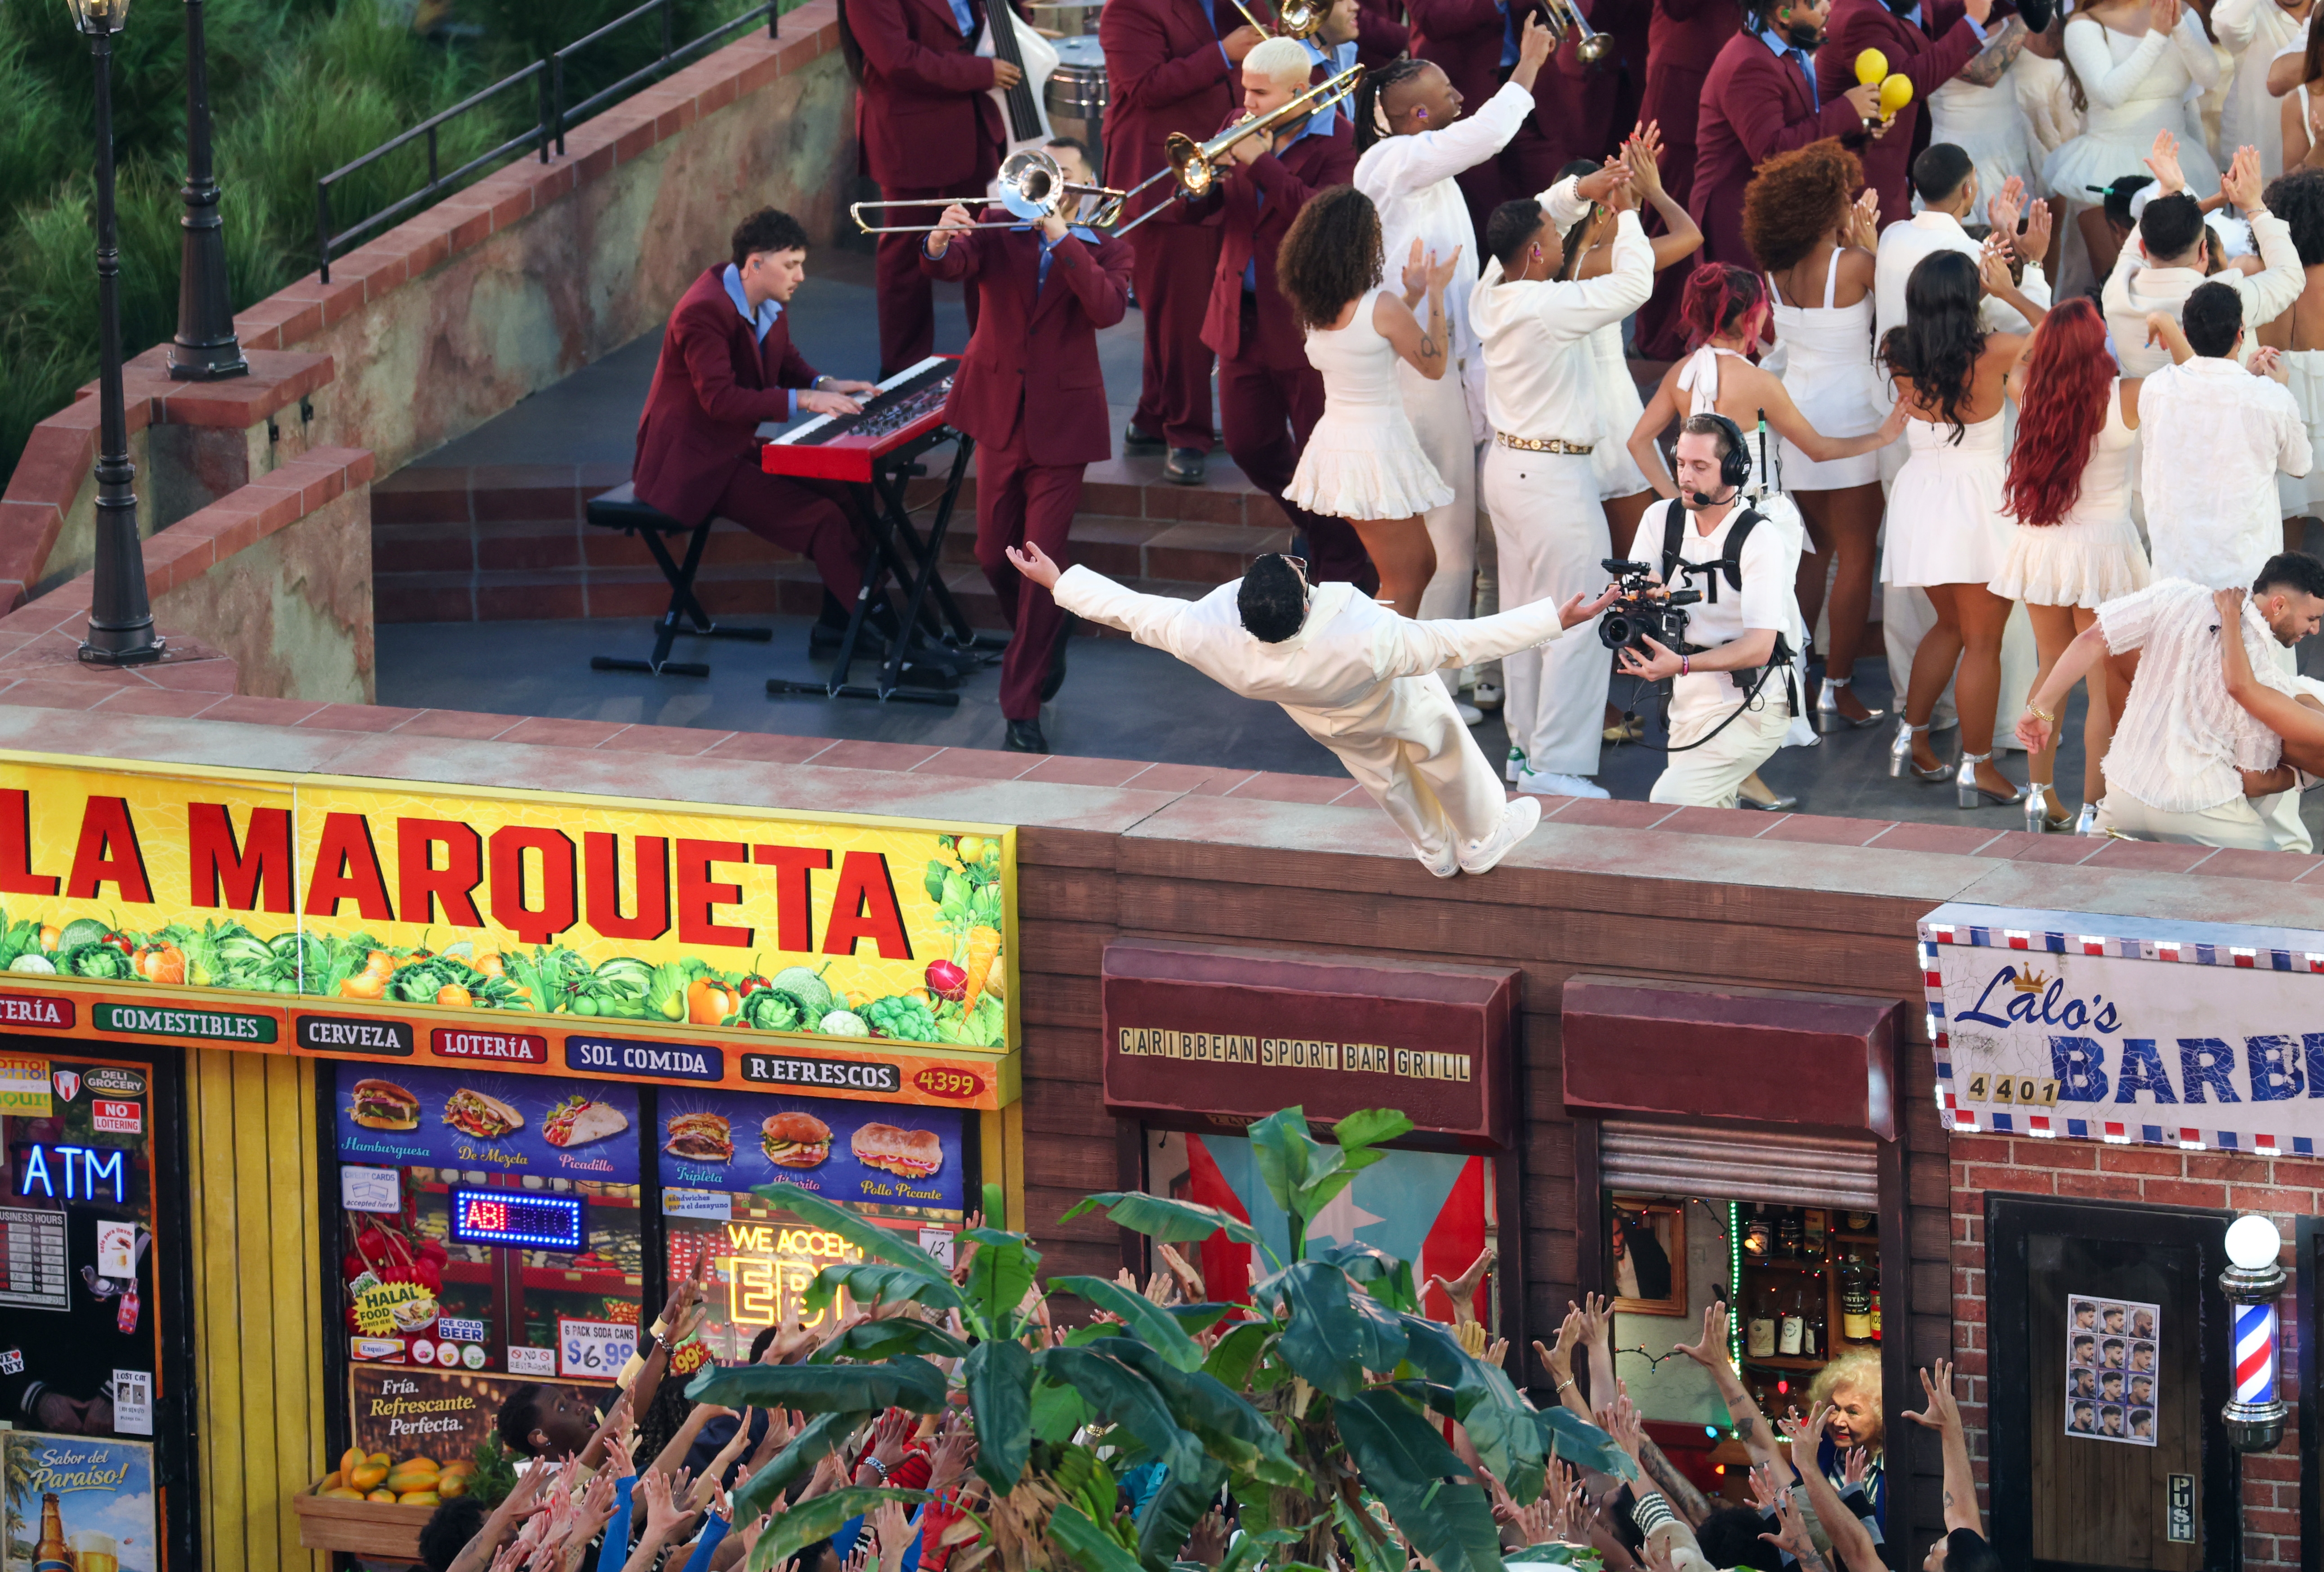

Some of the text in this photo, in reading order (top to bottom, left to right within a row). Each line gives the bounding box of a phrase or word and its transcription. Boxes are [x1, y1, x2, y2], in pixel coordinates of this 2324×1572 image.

[0, 788, 914, 960] LA MARQUETA
[1954, 965, 2122, 1034] Lalo's
[112, 1008, 258, 1038] COMESTIBLES
[309, 1023, 401, 1048] CERVEZA
[445, 1034, 533, 1059] LOTERÍA
[1120, 1029, 1468, 1080] CARIBBEAN SPORT BAR GRILL
[581, 1045, 708, 1074] SOL COMIDA
[101, 1070, 127, 1081] DELI
[751, 1058, 892, 1088] REFRESCOS
[88, 1078, 142, 1091] GROCERY
[919, 1072, 974, 1095] 4399
[1970, 1078, 2056, 1103] 4401
[0, 1092, 48, 1107] QUI!
[105, 1103, 128, 1117] NO
[96, 1118, 138, 1130] LOITERING
[341, 1136, 430, 1159] Hamburguesa
[458, 1146, 528, 1168] De Mezcla
[559, 1154, 614, 1172] Picadillo
[22, 1144, 124, 1203] ATM
[372, 1173, 396, 1181] CARDS
[677, 1166, 723, 1186] Tripleta
[861, 1180, 943, 1200] Pollo Picante
[346, 1200, 376, 1208] accepted
[694, 1202, 728, 1210] desayuno
[35, 1214, 63, 1225] HOURS
[728, 1224, 864, 1259] WE ACCEP
[928, 1240, 945, 1257] 12
[365, 1286, 419, 1309] HALAL
[360, 1307, 390, 1322] FOOD
[441, 1326, 482, 1341] BEER
[565, 1326, 634, 1340] 6 PACK SODA CANS
[524, 1350, 536, 1361] NO
[567, 1339, 633, 1371] $6.99
[4, 1361, 22, 1373] NY
[381, 1378, 419, 1395] Fría.
[370, 1395, 476, 1418] Refrescante.
[389, 1416, 464, 1436] Perfecta.
[39, 1449, 109, 1467] Sabor del
[30, 1463, 129, 1493] Paraíso!
[2173, 1478, 2190, 1538] PUSH
